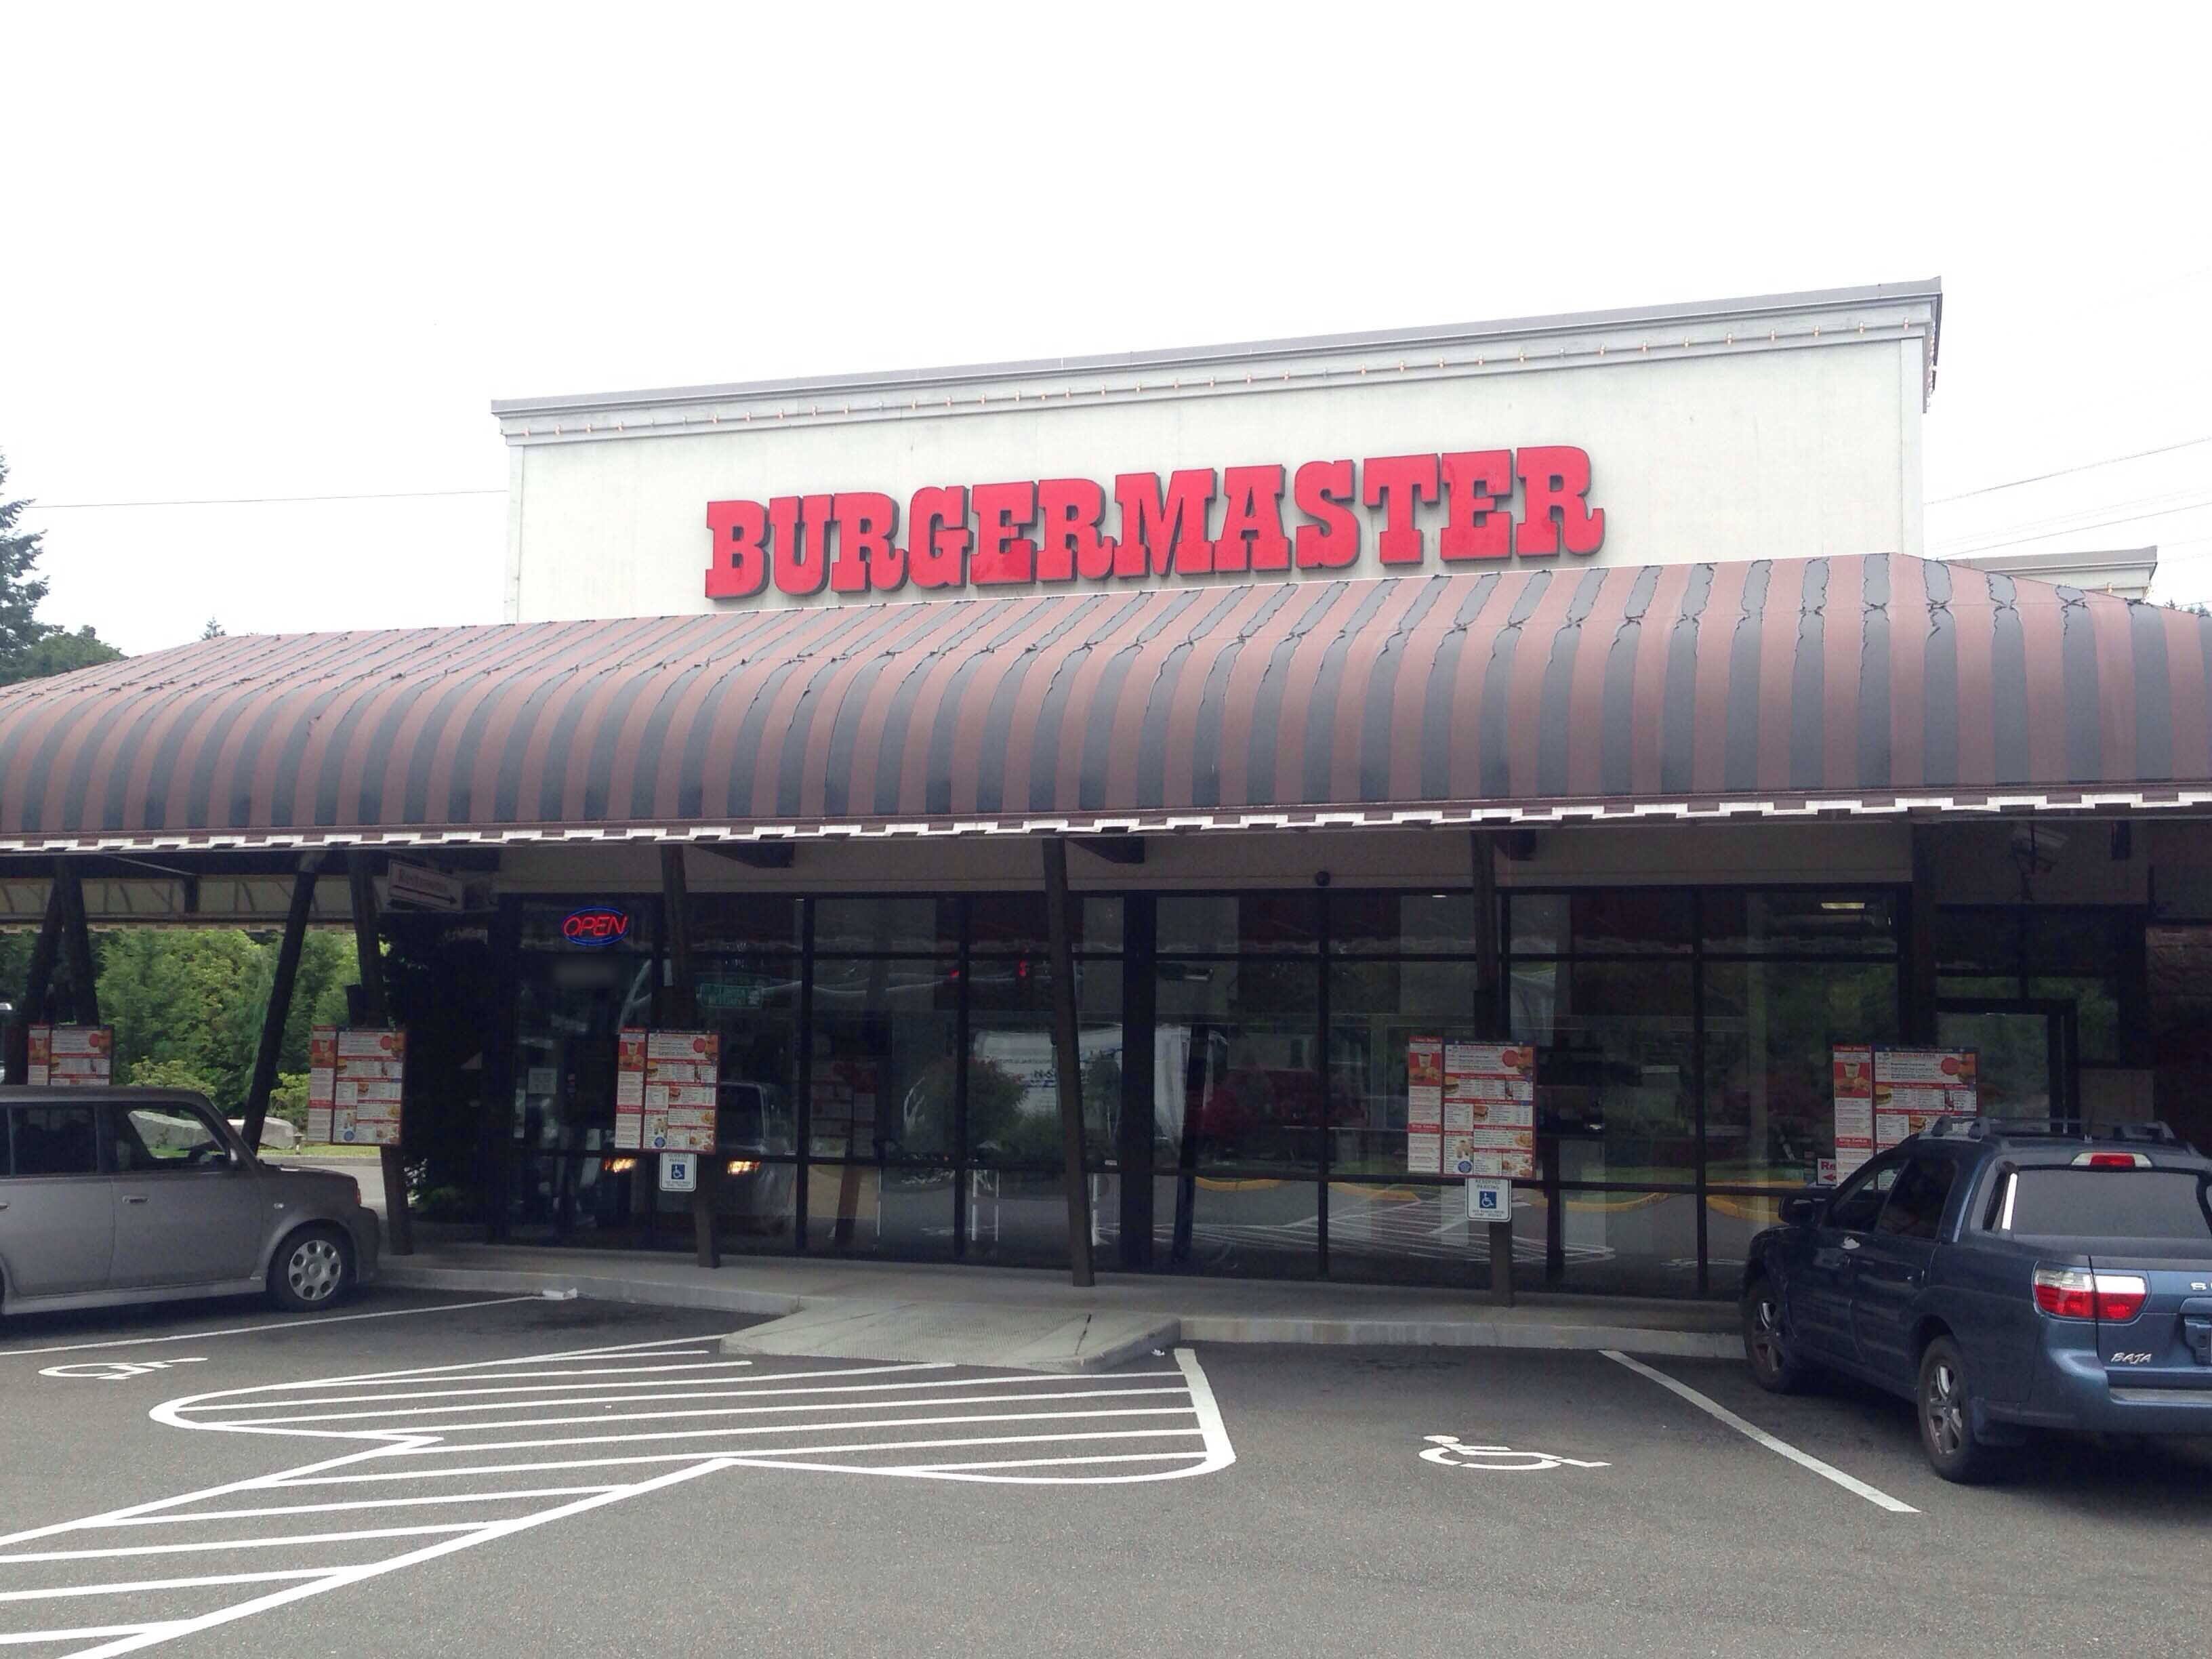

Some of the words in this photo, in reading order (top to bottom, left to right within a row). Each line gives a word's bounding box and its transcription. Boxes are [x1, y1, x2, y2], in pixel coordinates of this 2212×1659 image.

[705, 445, 1605, 602] BURGERMASTER
[563, 914, 628, 937] OPEN
[2110, 1352, 2152, 1364] BAJA
